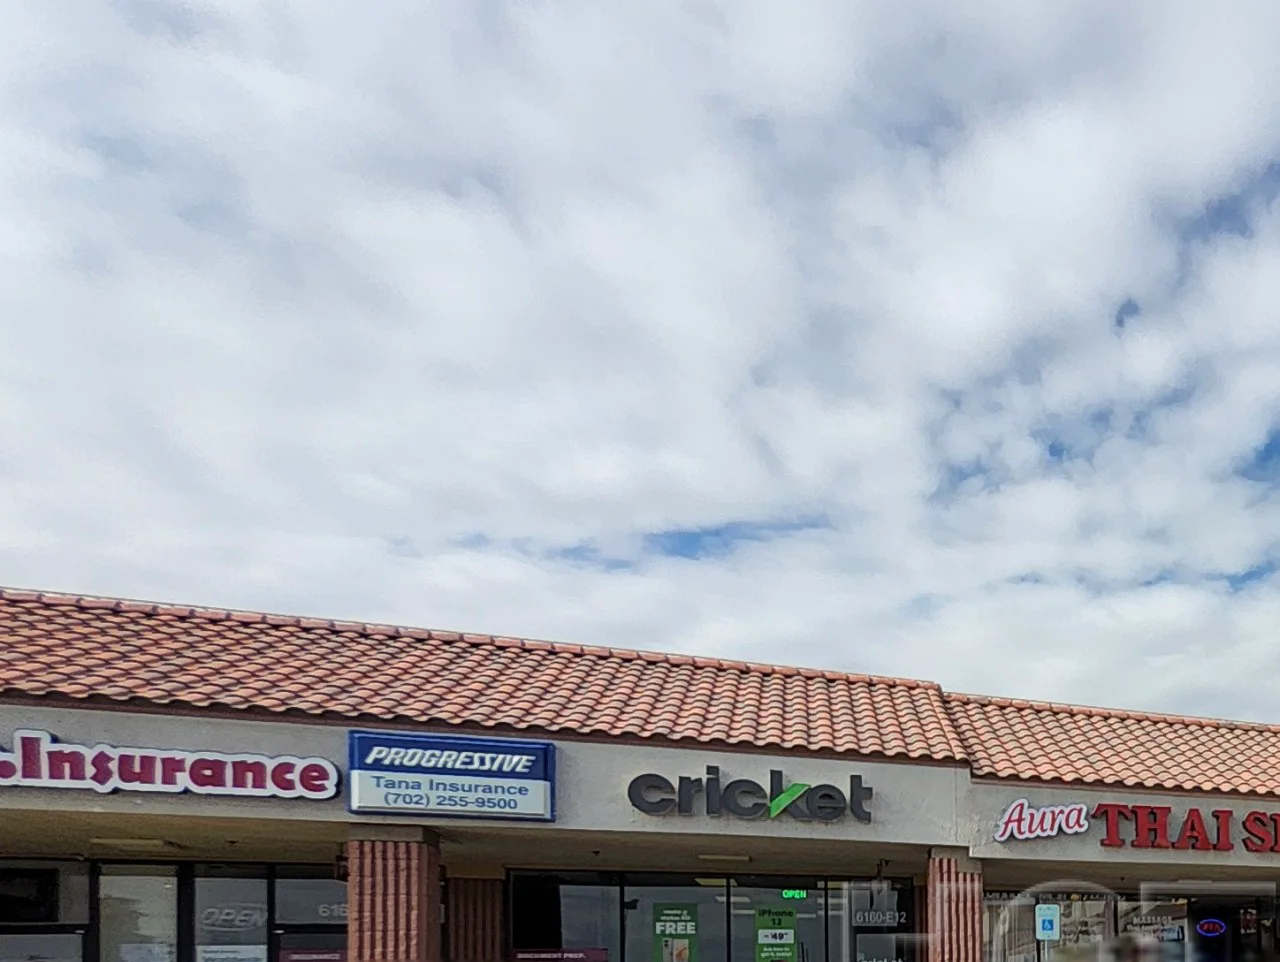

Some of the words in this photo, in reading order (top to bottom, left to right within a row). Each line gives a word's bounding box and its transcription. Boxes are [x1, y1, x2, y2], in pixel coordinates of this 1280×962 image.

[364, 747, 536, 773] PROGRESSIVE
[371, 776, 422, 790] Tana
[429, 779, 529, 796] Insurance
[628, 765, 873, 823] cricket
[384, 792, 430, 808] (702)
[436, 795, 518, 809] 255-9500
[996, 799, 1087, 841] Aura
[1091, 803, 1234, 850] THAI
[782, 889, 807, 898] OPEN
[655, 922, 697, 935] FREE
